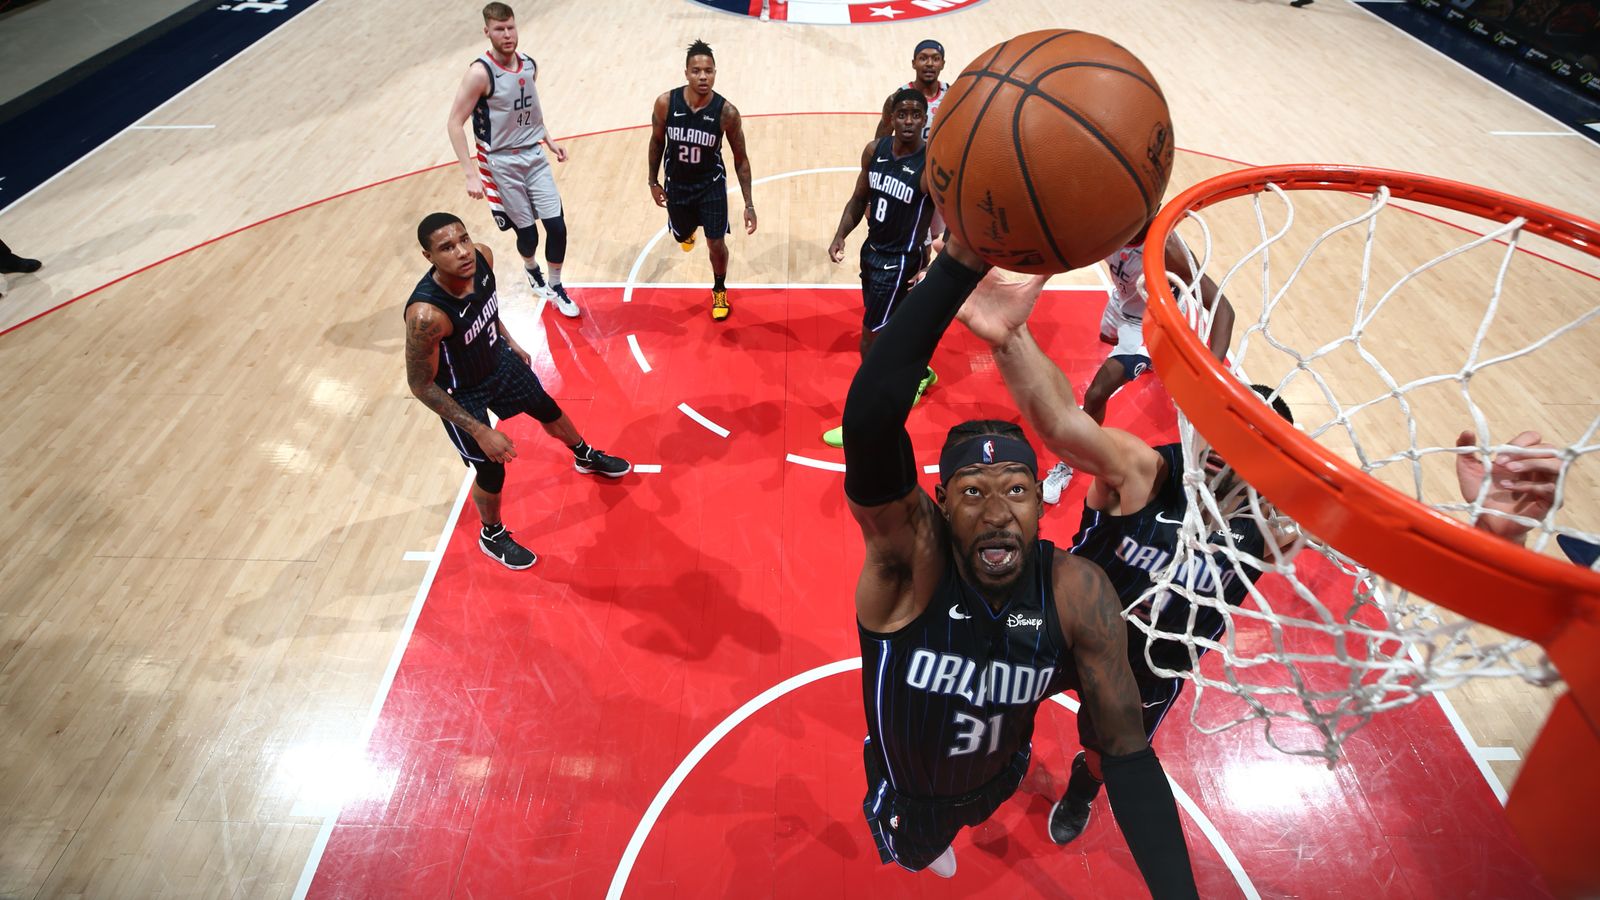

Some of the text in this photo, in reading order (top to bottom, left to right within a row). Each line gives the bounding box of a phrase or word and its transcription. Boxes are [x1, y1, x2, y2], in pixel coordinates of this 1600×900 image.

[516, 111, 531, 126] 42
[667, 126, 716, 147] ORLANDO
[679, 145, 701, 164] 20
[868, 171, 914, 204] ORLANDO
[875, 197, 888, 223] 8
[464, 291, 499, 346] ORLAND
[487, 321, 498, 347] 3
[1115, 536, 1236, 594] ORLNDO
[1006, 613, 1043, 630] Disney
[906, 649, 1055, 707] ORLANDO
[949, 711, 1004, 757] 31
